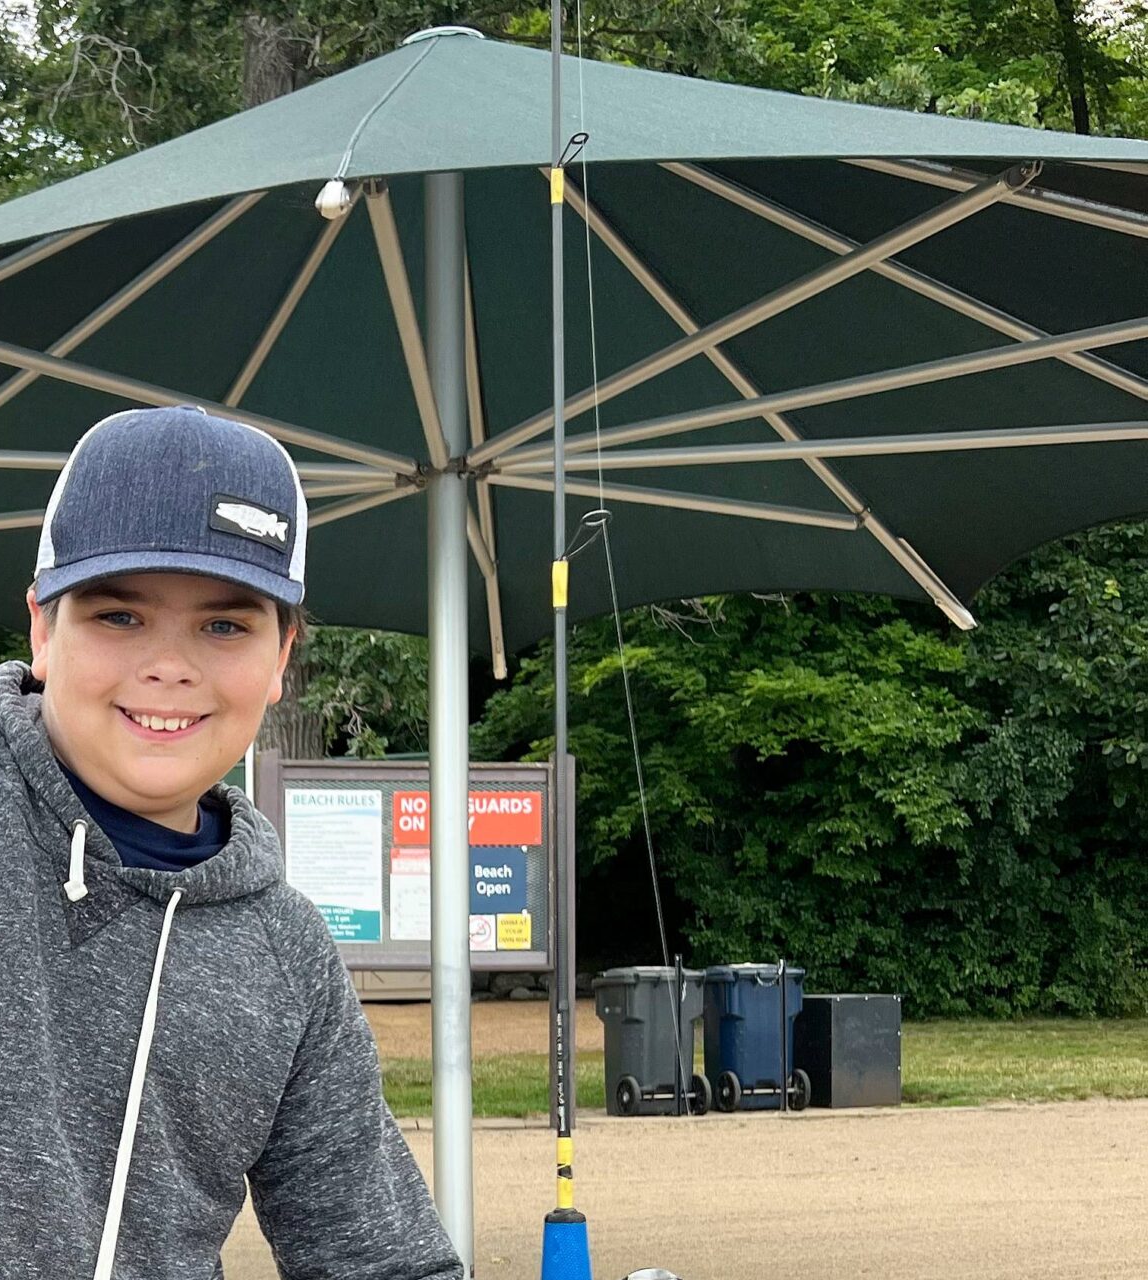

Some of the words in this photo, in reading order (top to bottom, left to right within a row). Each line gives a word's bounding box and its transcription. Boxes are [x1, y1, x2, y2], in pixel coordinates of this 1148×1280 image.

[293, 794, 333, 806] BEACH
[338, 794, 375, 807] RULES
[401, 798, 427, 814] NO
[399, 816, 425, 831] ON
[474, 864, 513, 878] Beach
[476, 881, 511, 897] Open
